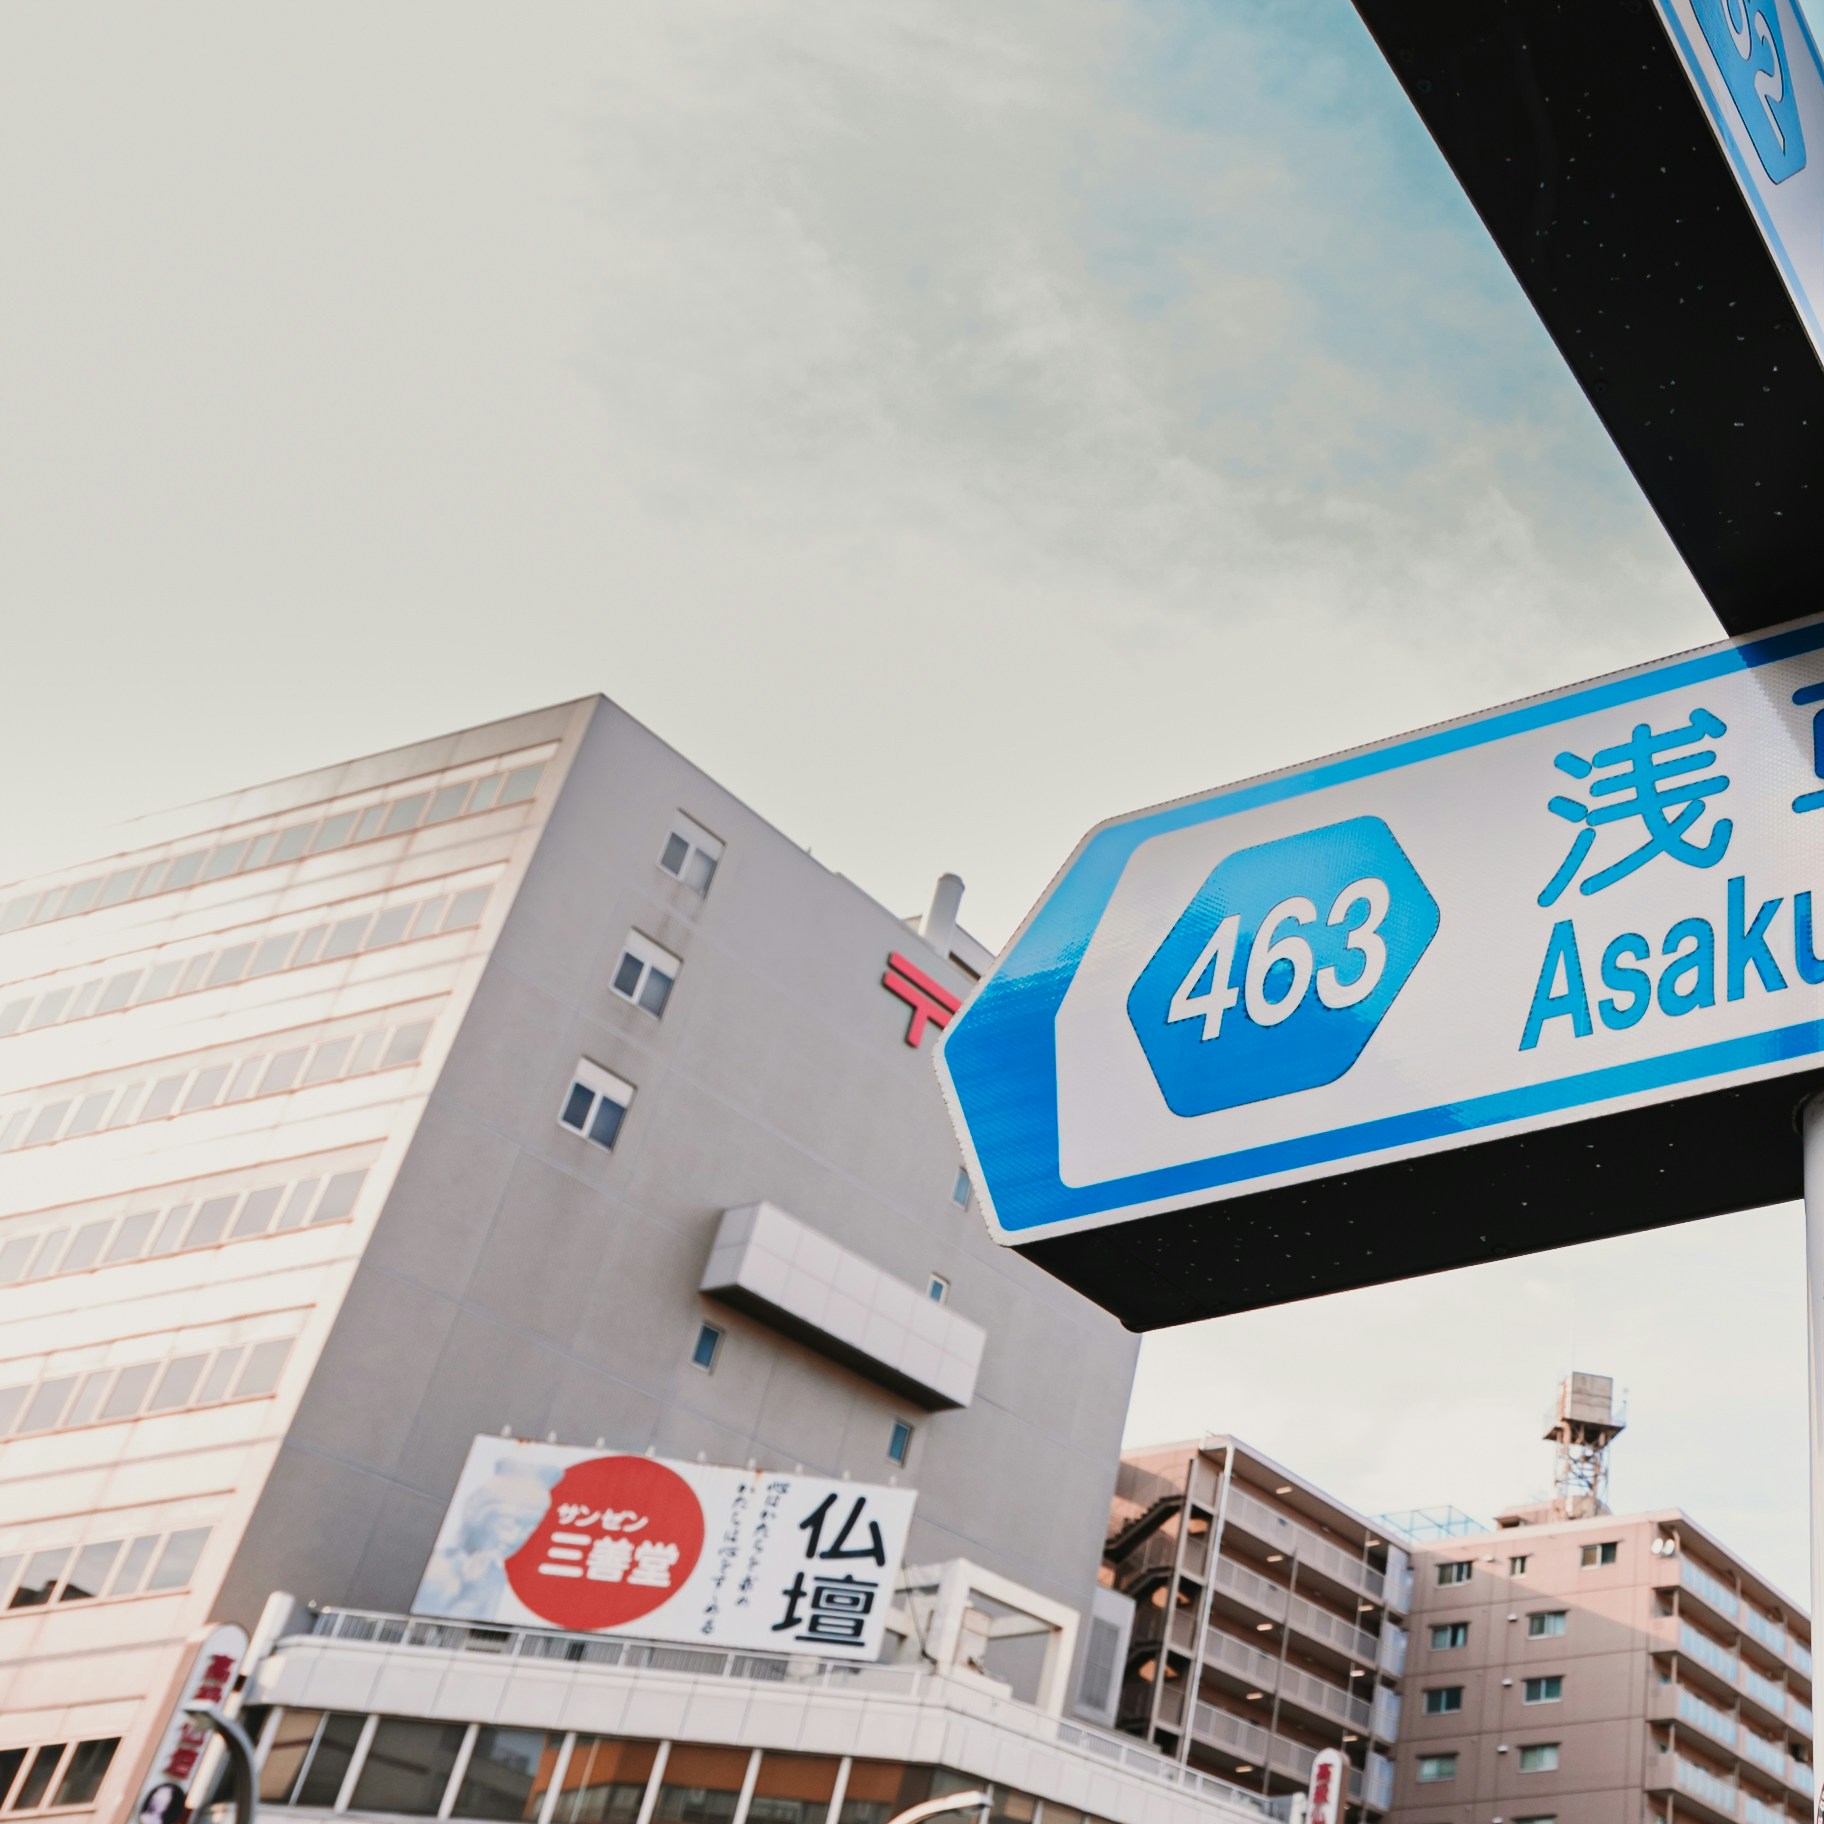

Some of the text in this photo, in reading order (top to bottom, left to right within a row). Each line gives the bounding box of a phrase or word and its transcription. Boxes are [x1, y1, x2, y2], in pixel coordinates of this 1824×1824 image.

[1167, 876, 1390, 1041] 463
[537, 1531, 681, 1588] 三善堂
[772, 1493, 885, 1647] 仏壇
